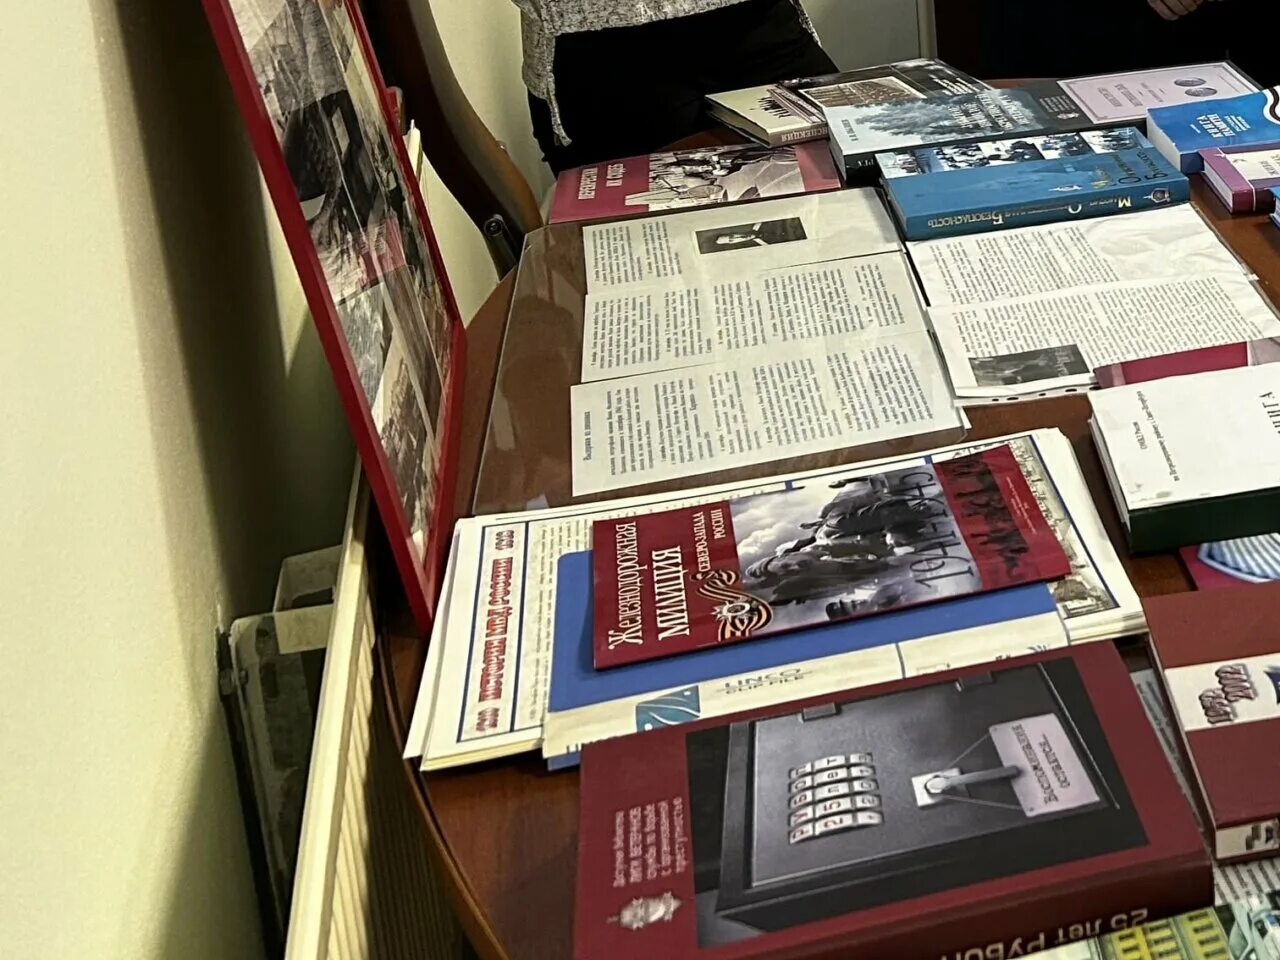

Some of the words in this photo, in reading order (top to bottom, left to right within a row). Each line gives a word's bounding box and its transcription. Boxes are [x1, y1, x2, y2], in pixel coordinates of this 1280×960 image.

[693, 511, 711, 572] СЕВЕРО-ЗАПАДА
[489, 557, 514, 606] РОССИИ
[607, 521, 649, 651] Железнодорожная
[651, 545, 690, 642] МИЛИЦИЯ
[482, 640, 508, 701] ИСТОРИЯ
[1057, 916, 1103, 944] лет
[1110, 907, 1149, 929] 25
